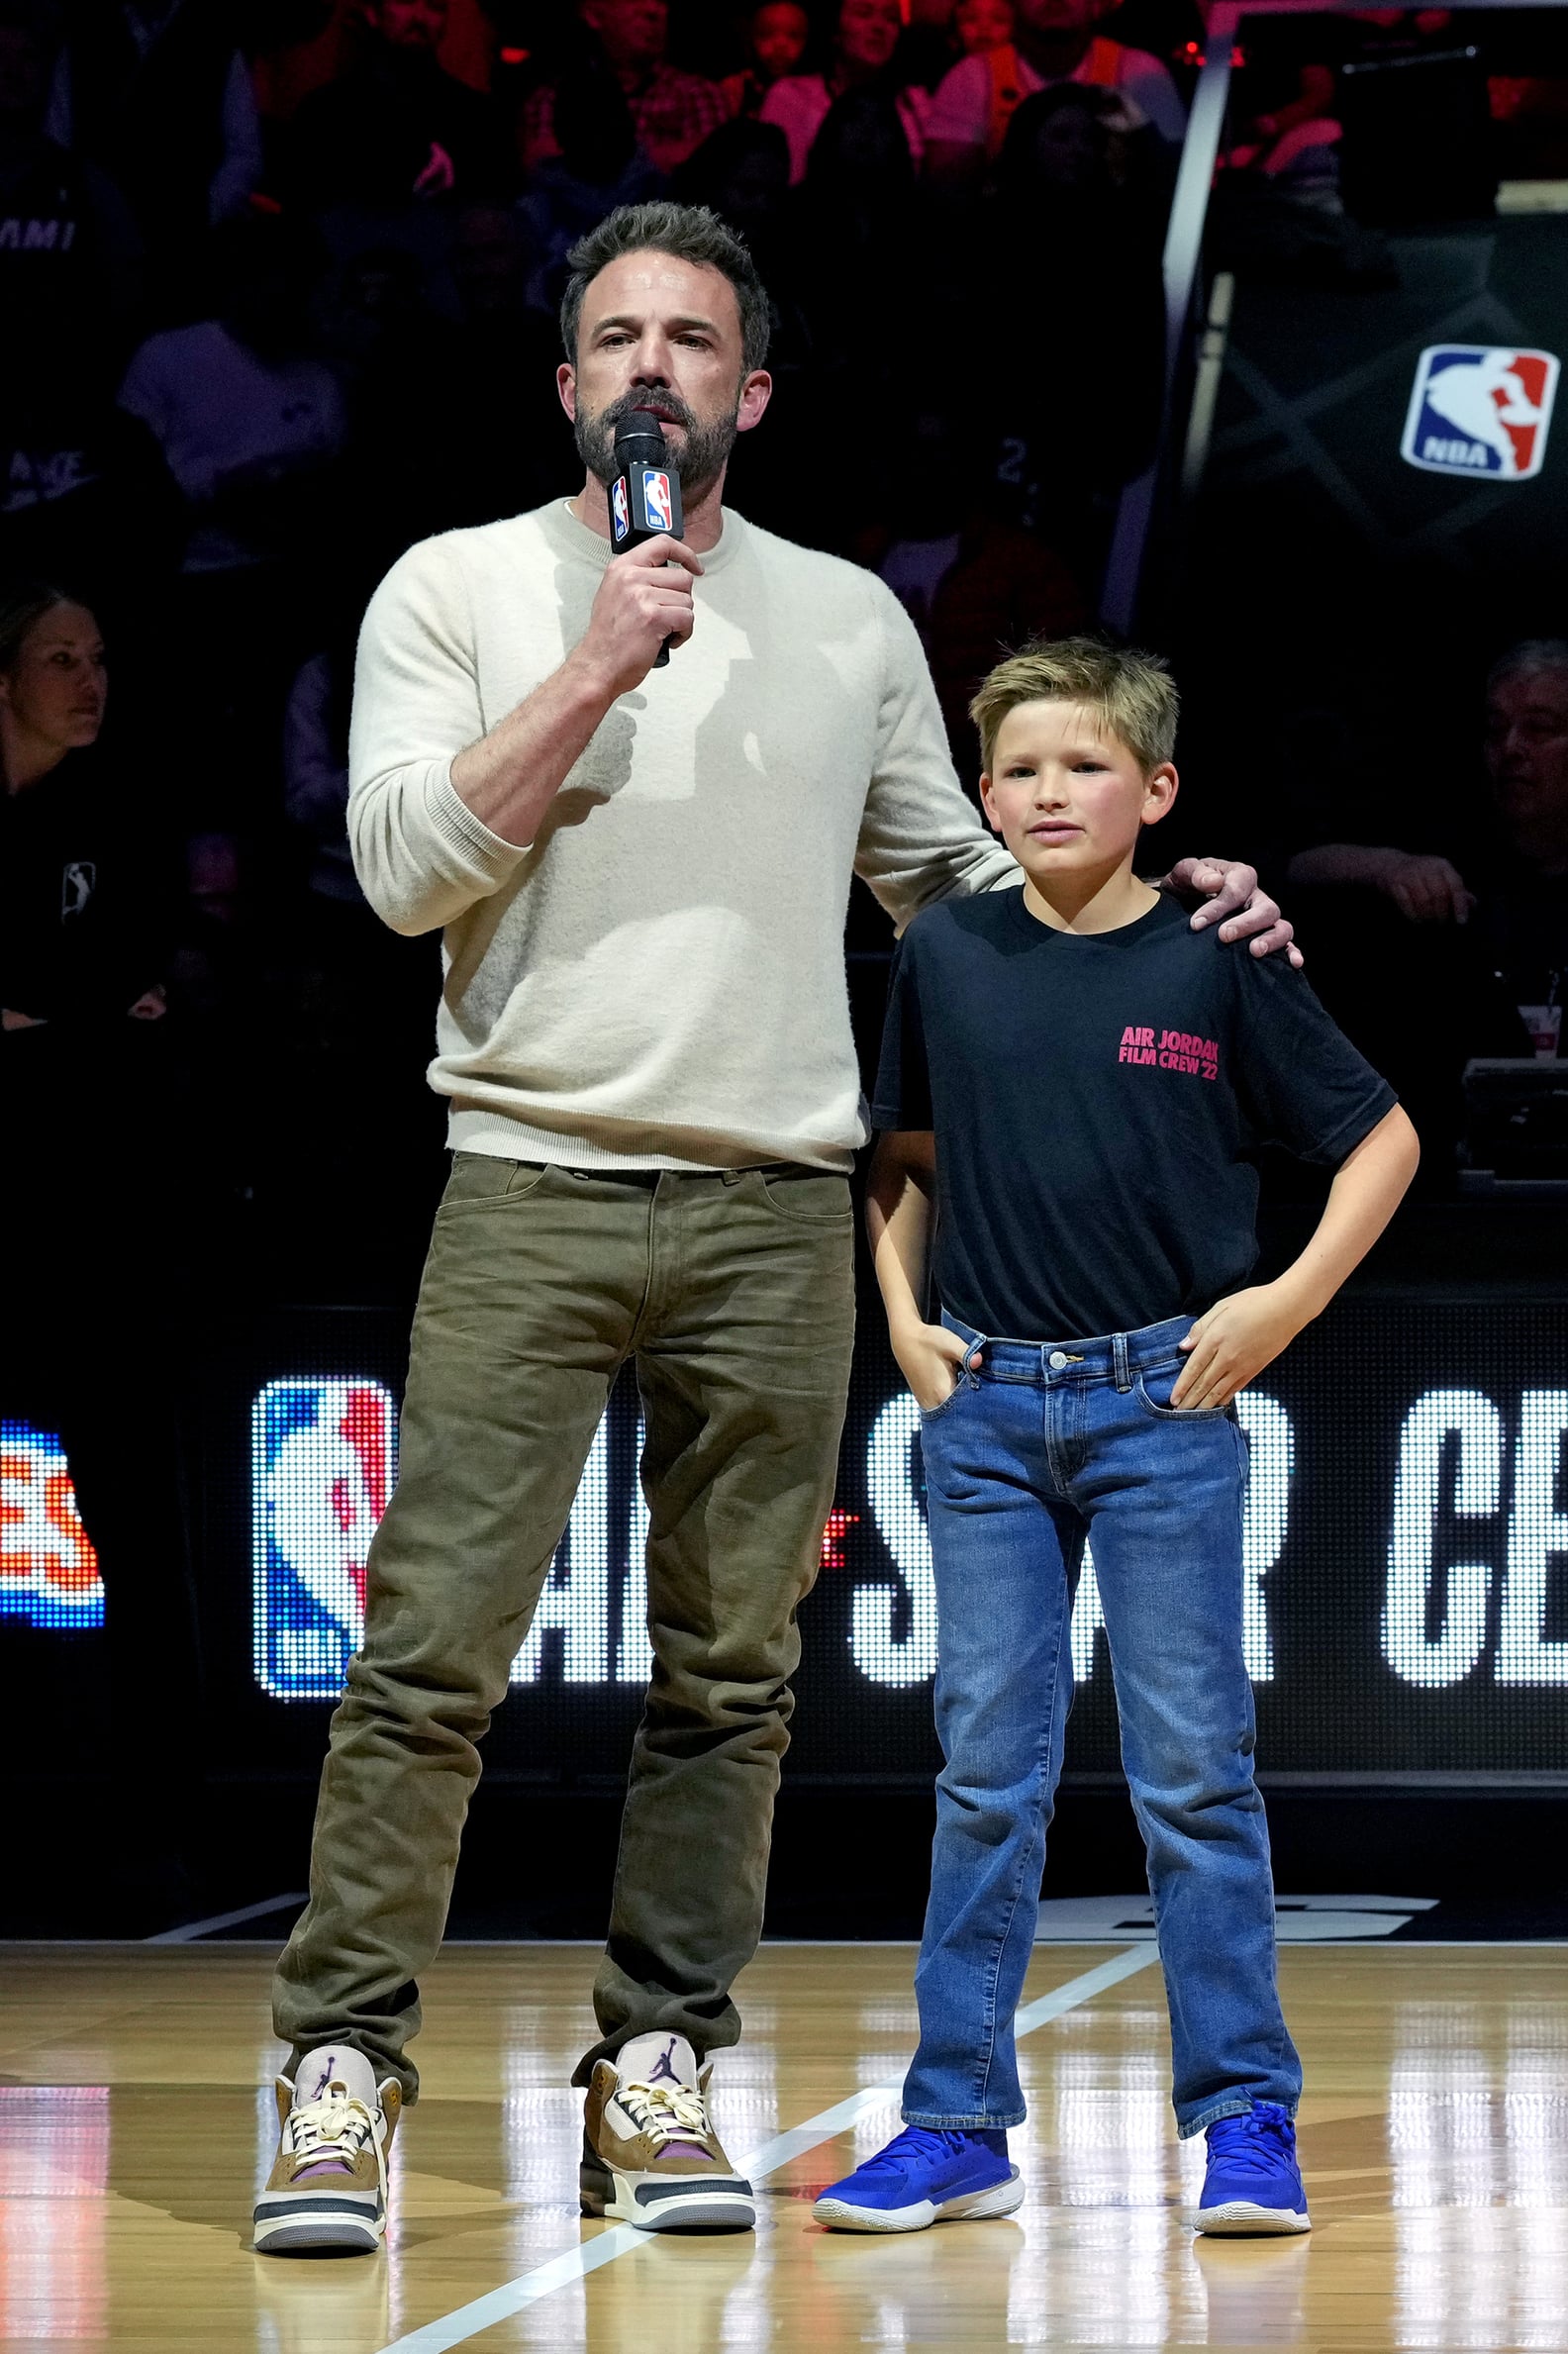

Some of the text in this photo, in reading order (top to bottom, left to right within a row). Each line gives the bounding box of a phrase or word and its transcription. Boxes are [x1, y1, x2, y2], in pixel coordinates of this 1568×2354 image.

[1423, 436, 1488, 466] NBA
[1120, 1026, 1219, 1062] AIR JORDAN
[1119, 1046, 1157, 1065] FILM
[1159, 1050, 1200, 1075] CREW
